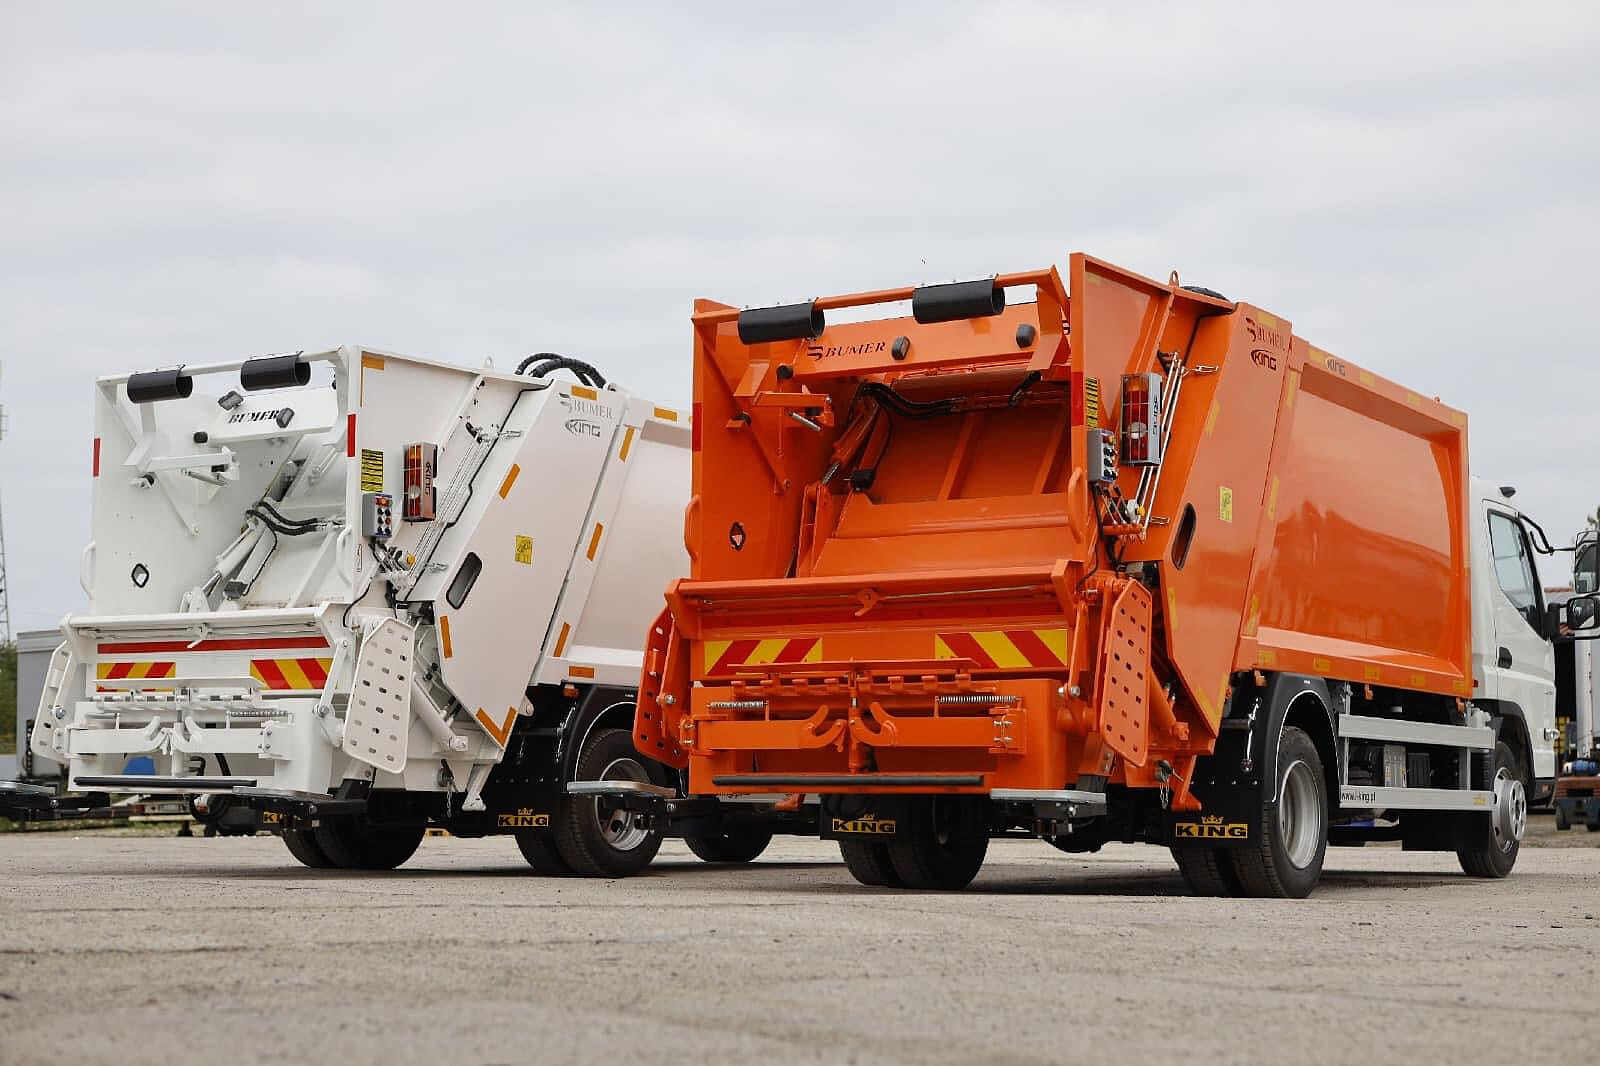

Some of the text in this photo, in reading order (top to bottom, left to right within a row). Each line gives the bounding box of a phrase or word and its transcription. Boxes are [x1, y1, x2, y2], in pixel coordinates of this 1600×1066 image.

[825, 341, 886, 358] BUMER
[1251, 349, 1277, 371] KING
[565, 418, 601, 438] KING
[498, 814, 548, 827] KING
[832, 818, 896, 833] KING
[1175, 822, 1248, 838] KING
